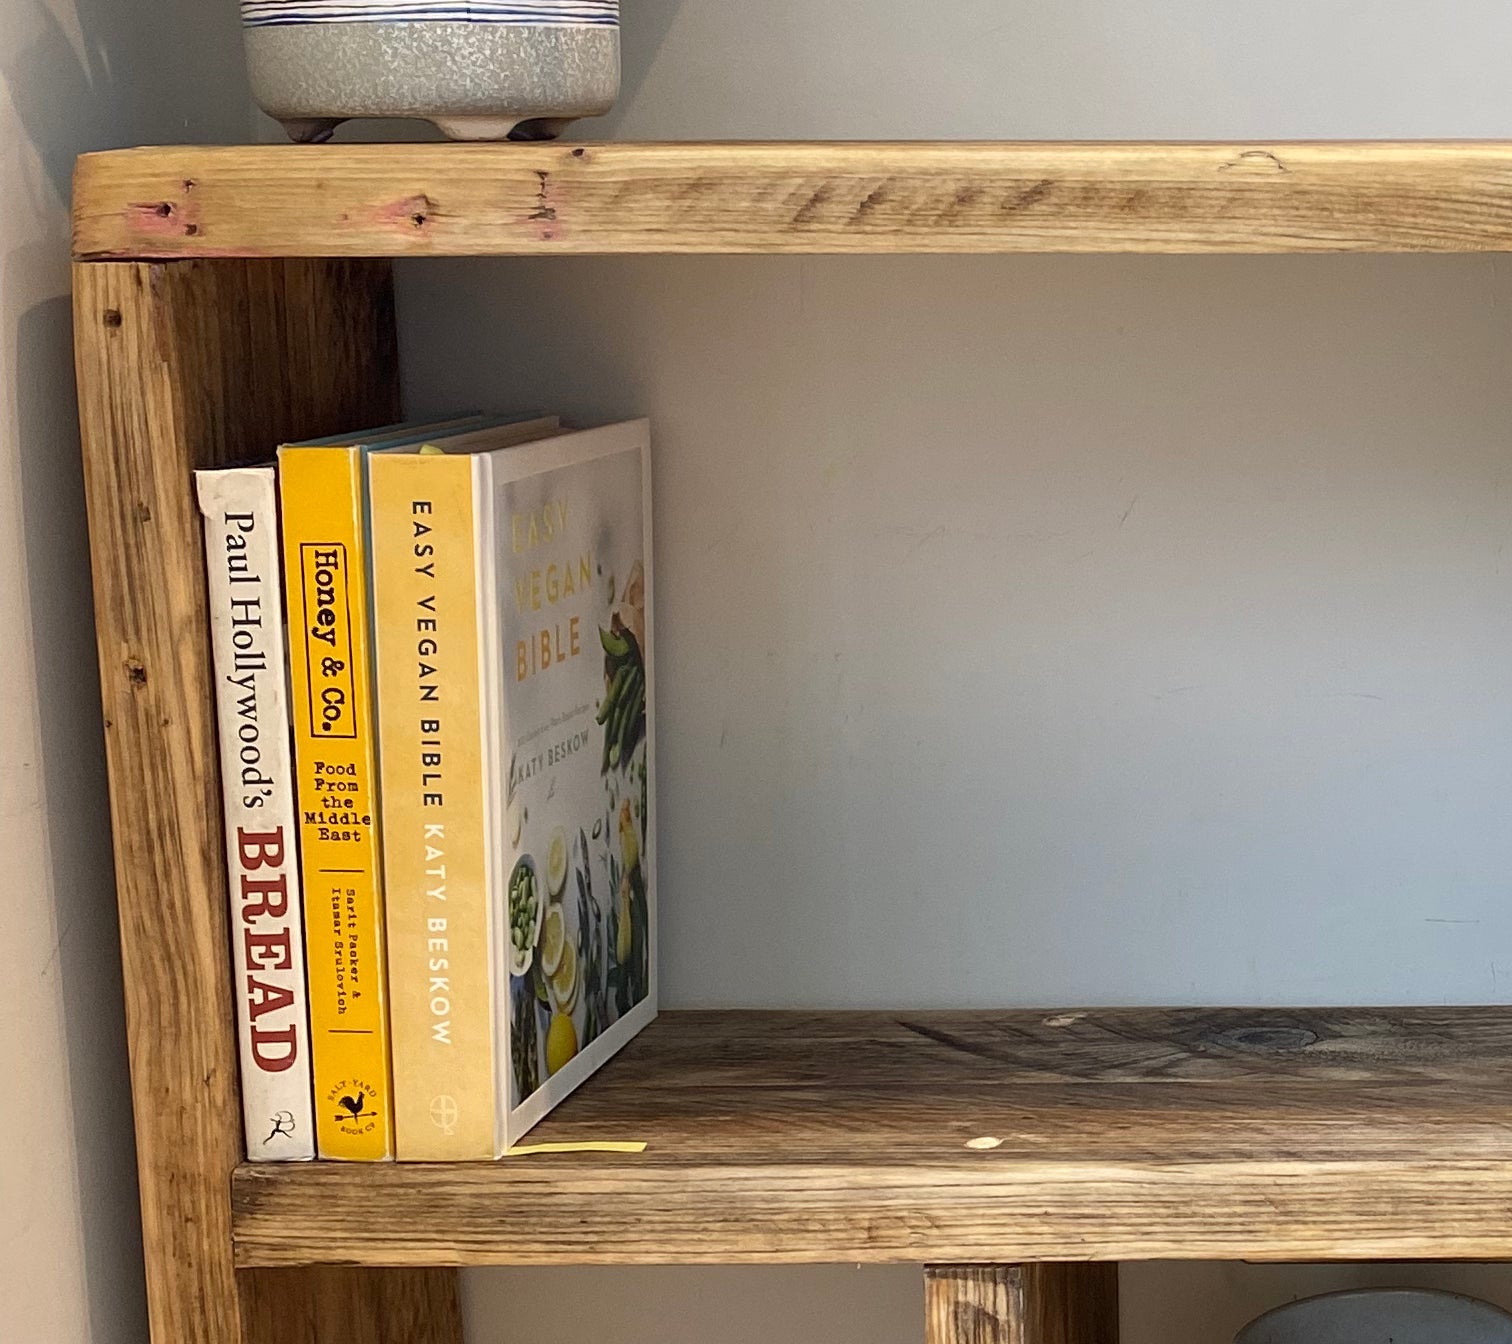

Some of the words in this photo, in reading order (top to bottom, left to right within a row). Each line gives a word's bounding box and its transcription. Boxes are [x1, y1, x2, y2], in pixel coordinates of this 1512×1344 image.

[224, 511, 261, 585] Paul
[412, 500, 435, 579] EASY
[512, 497, 568, 554] EASY
[311, 549, 340, 647] Honey
[515, 550, 592, 615] VEGAN
[321, 657, 345, 678] &
[416, 596, 440, 702] VEGAN
[516, 616, 580, 682] BIBLE
[226, 597, 274, 809] Hollywood's
[320, 687, 344, 733] Co.
[314, 761, 357, 776] Food
[420, 720, 443, 807] BIBLE
[547, 728, 589, 766] BESKOW
[314, 778, 359, 793] From
[321, 796, 353, 809] the
[305, 811, 371, 826] Middle
[318, 828, 361, 842] East
[424, 823, 448, 902] KATY
[237, 826, 298, 1073] BREAD
[428, 917, 452, 1046] BESKOW
